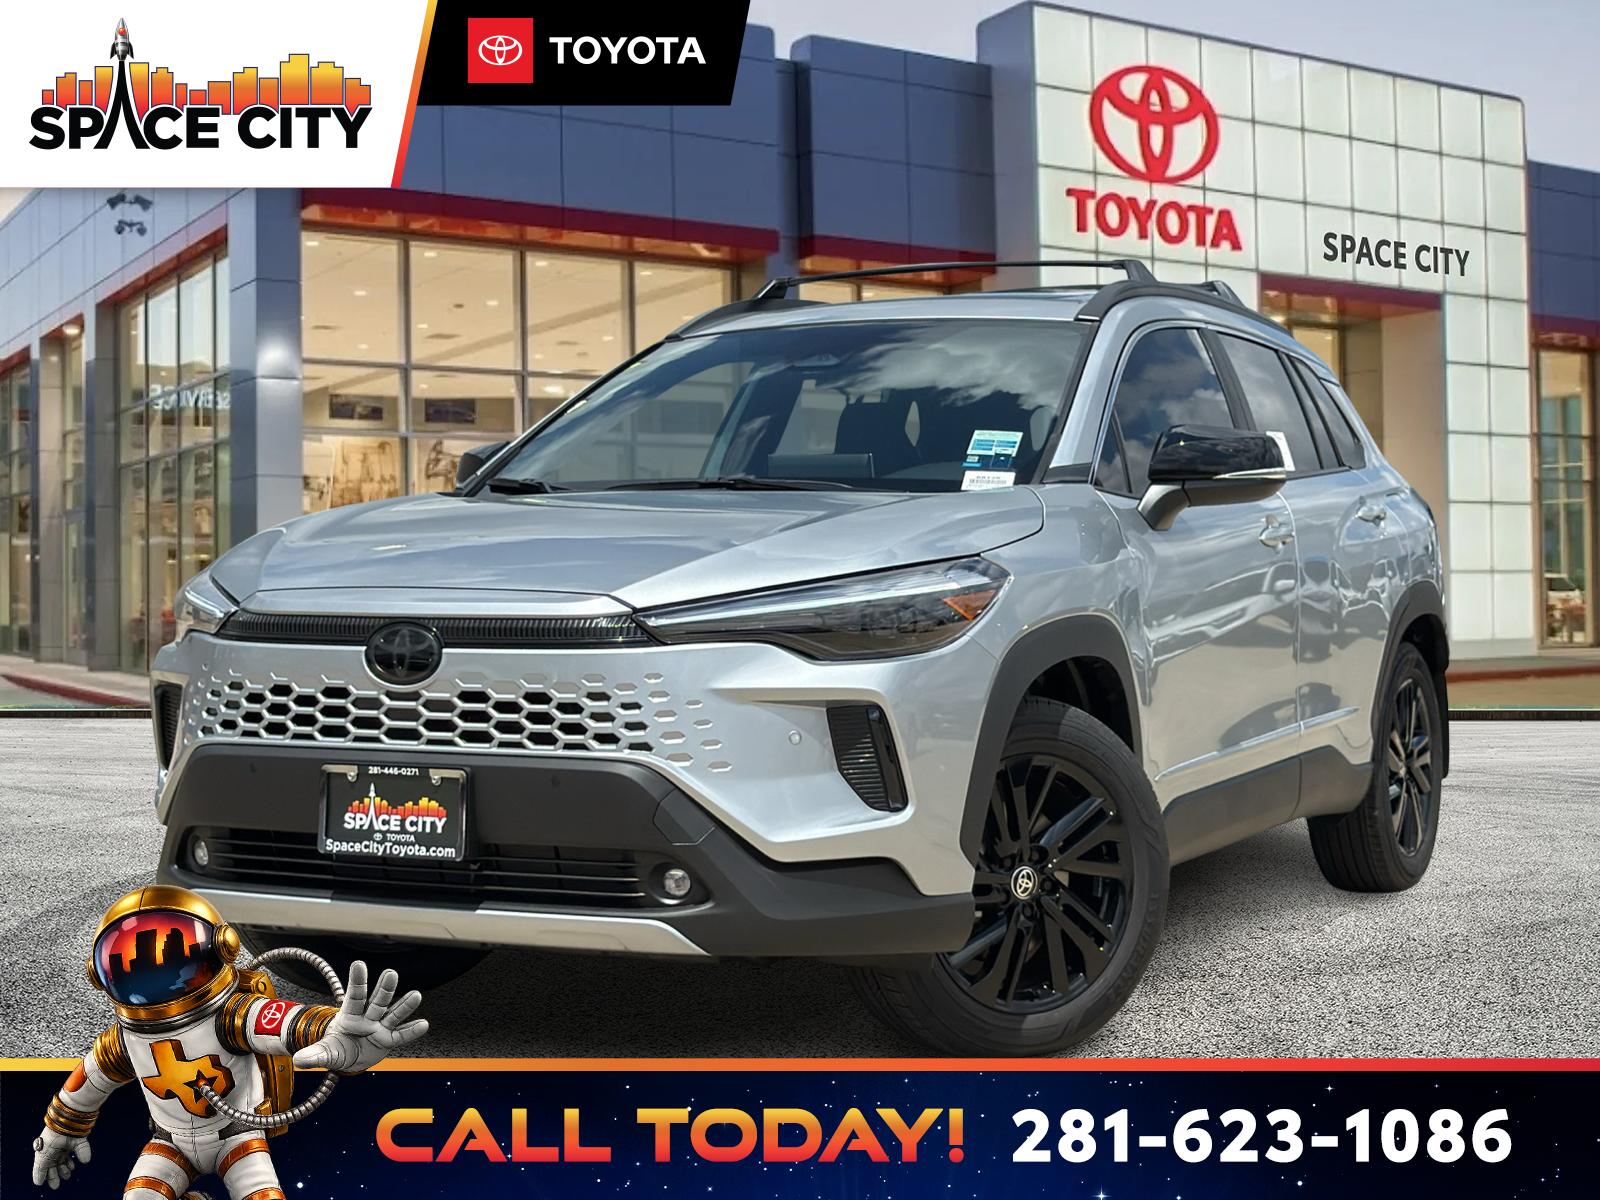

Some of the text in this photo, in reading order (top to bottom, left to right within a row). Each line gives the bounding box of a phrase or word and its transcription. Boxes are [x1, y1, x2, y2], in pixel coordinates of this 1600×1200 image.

[1066, 187, 1243, 252] TOYOTA
[1323, 231, 1470, 277] SPACE CITY
[368, 766, 420, 776] 281-446-0271
[343, 811, 448, 834] SPACE CITY
[325, 838, 456, 858] SpaceCityToyota.com
[386, 833, 416, 843] TOYOTA
